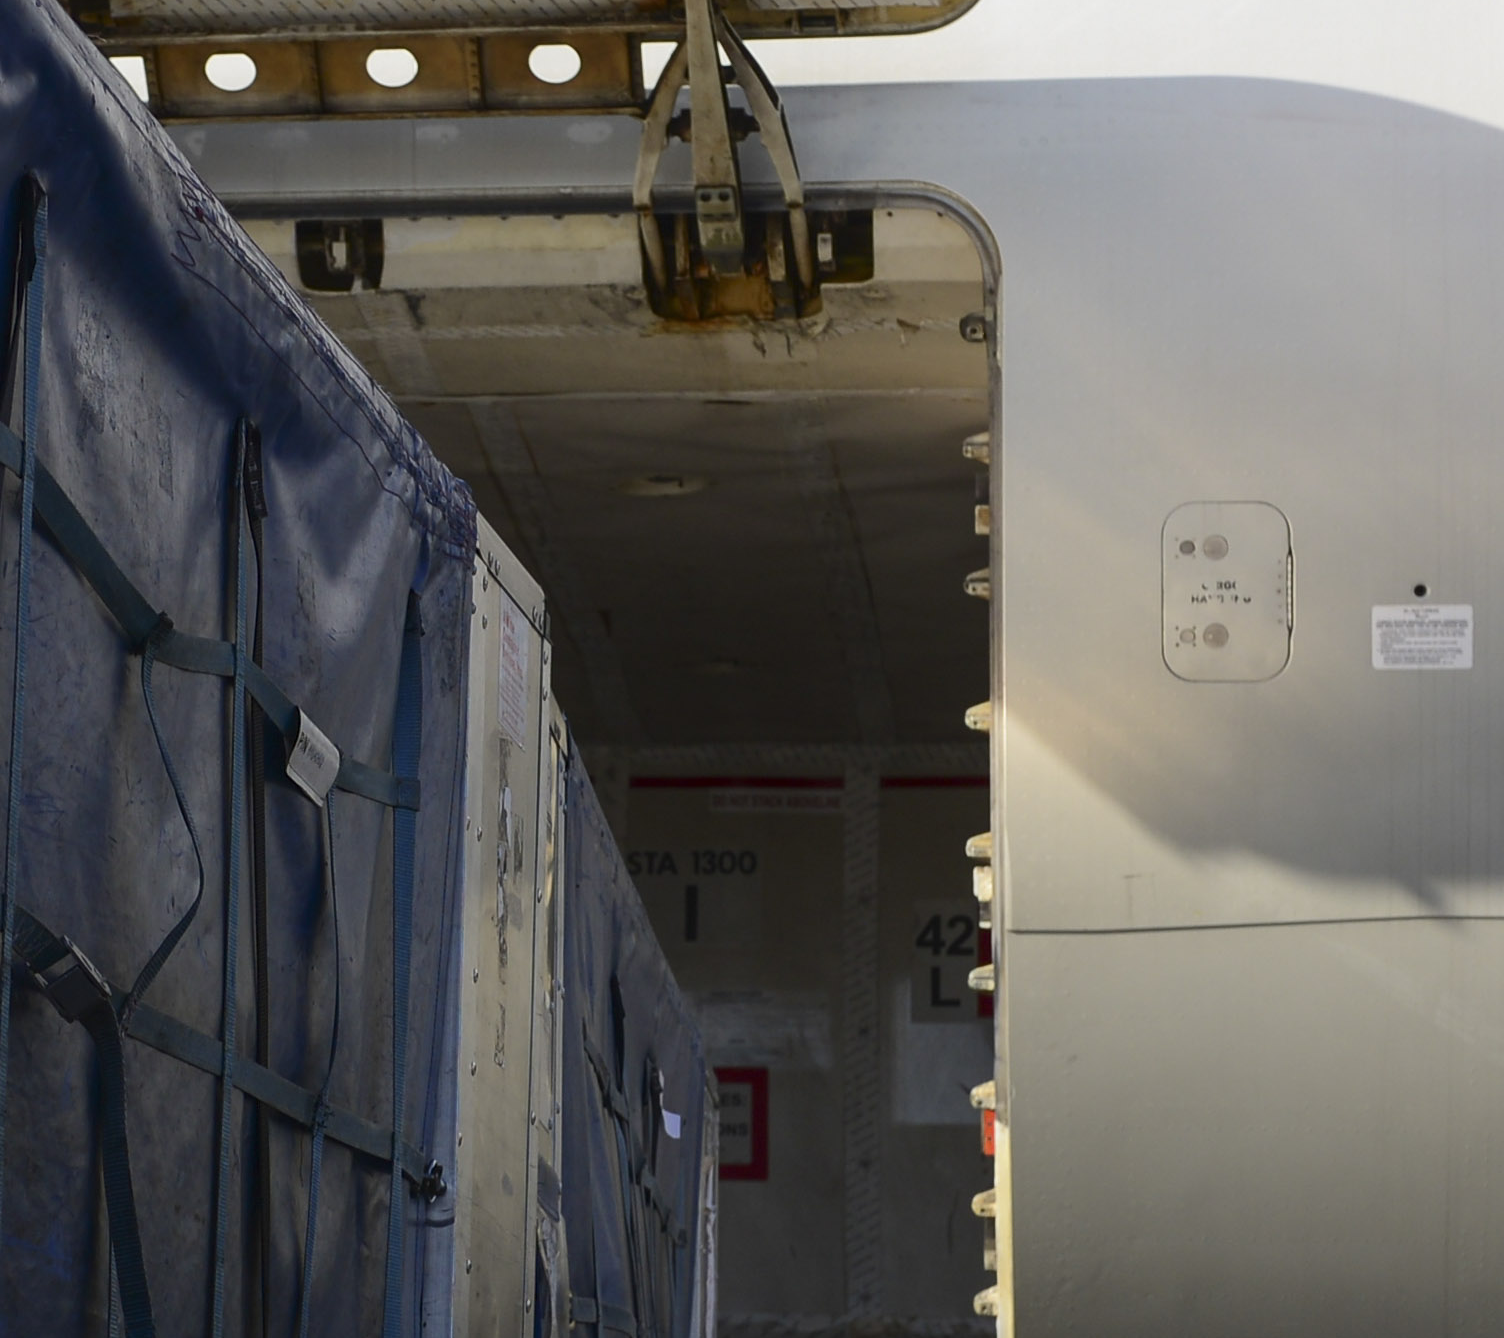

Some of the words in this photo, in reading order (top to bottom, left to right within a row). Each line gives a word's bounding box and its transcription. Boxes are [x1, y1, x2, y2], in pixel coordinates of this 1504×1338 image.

[626, 850, 679, 875] STA
[691, 850, 758, 875] 1300
[915, 915, 974, 957] 42
[930, 967, 961, 1008] L
